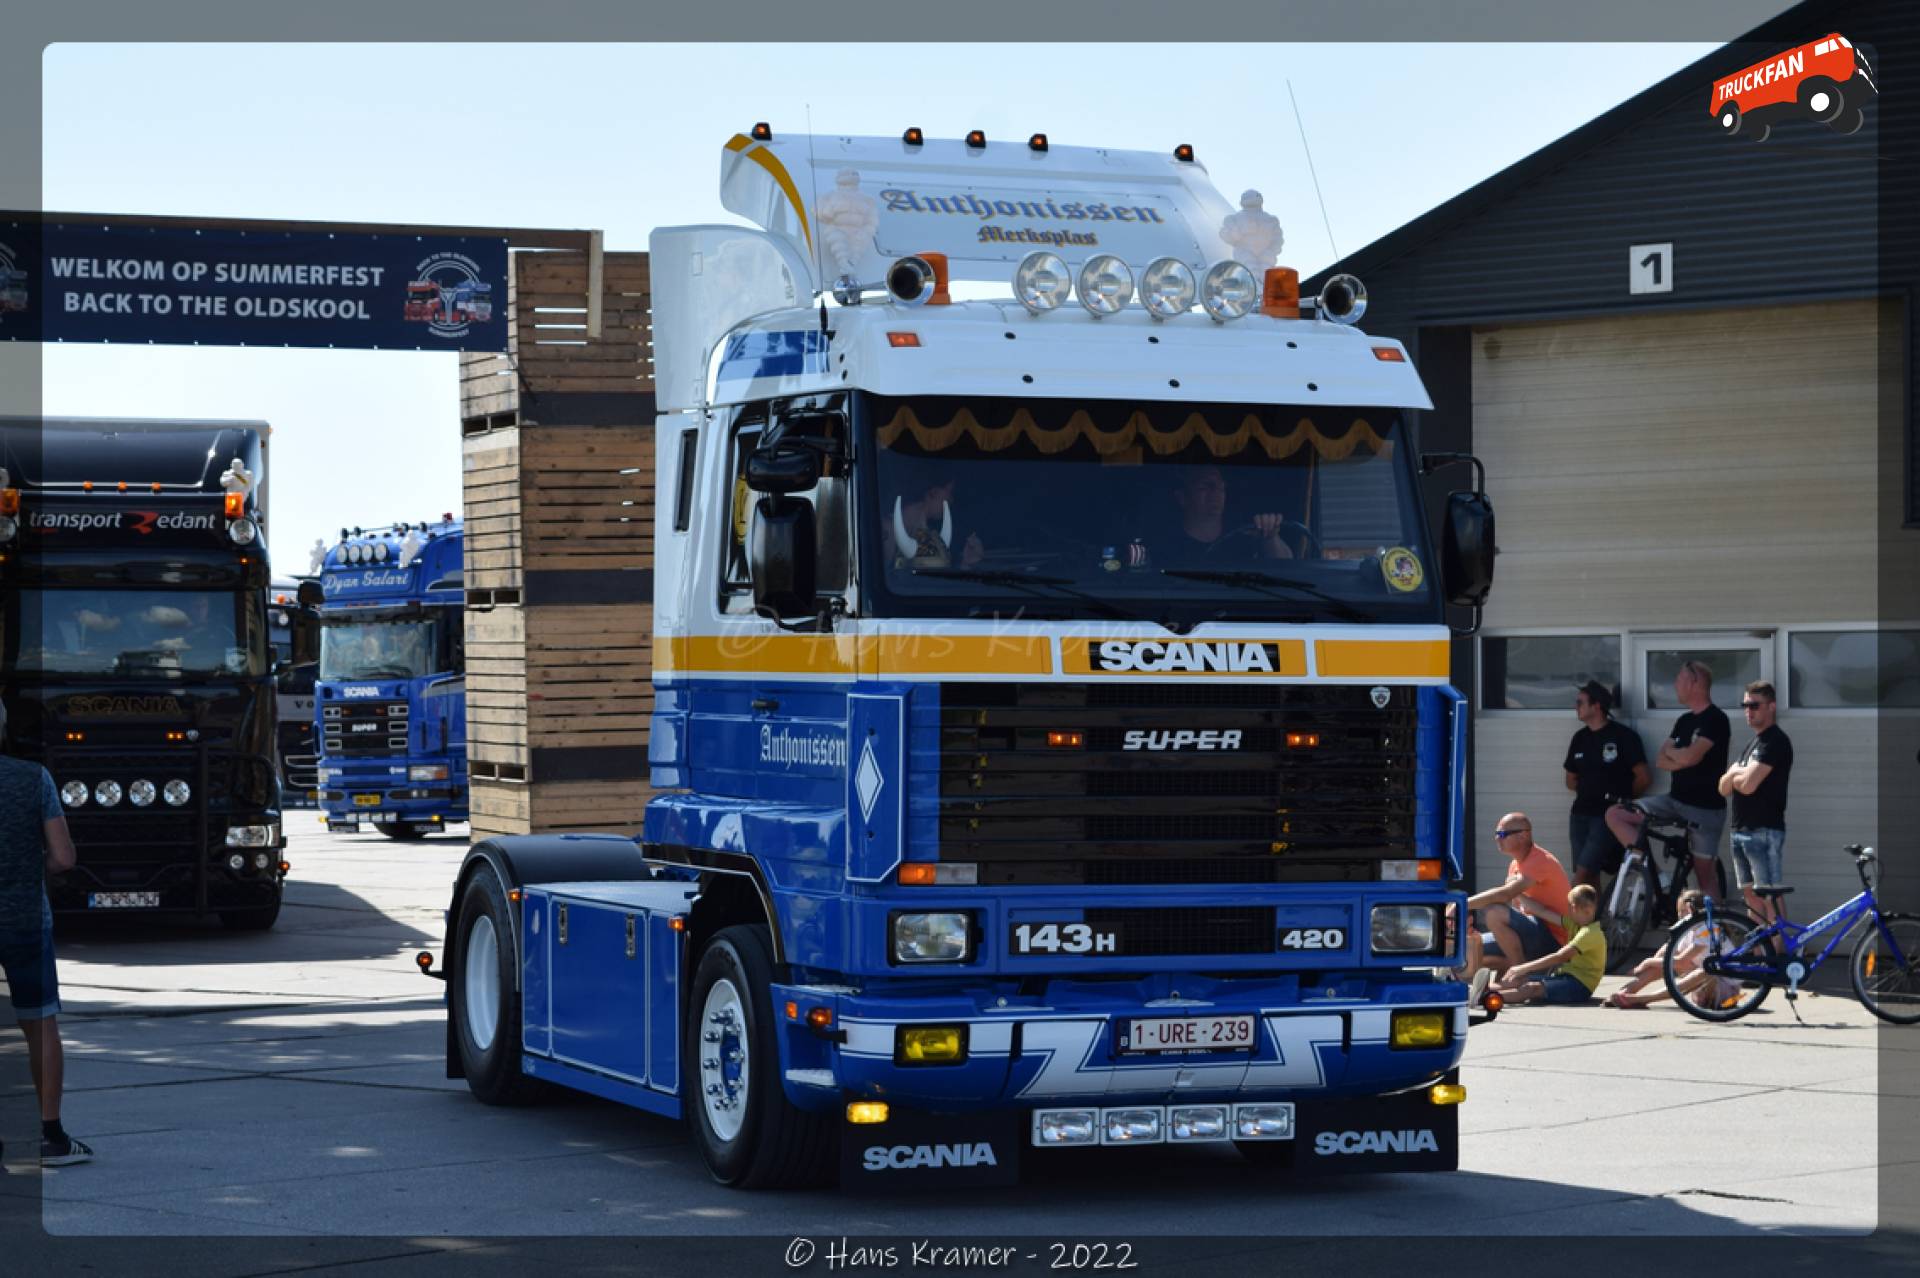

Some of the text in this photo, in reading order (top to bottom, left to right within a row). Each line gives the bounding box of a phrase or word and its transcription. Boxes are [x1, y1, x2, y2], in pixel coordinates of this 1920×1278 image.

[880, 188, 1164, 224] Anthonissen
[977, 225, 1099, 247] Merksplas
[51, 257, 385, 287] WELKOM OP SUMMERFEST
[1640, 252, 1662, 285] 1
[65, 292, 371, 320] BACK TO THE OLDSKOOL
[29, 512, 123, 531] transport
[1099, 641, 1274, 673] SCANIA
[68, 695, 182, 715] SCANIA
[343, 686, 380, 697] SCANIA
[760, 724, 846, 770] Anthonissen
[1123, 730, 1242, 751] SUPER
[1282, 928, 1343, 949] 420
[1314, 1129, 1439, 1155] SCANIA
[863, 1143, 998, 1171] SCANIA
